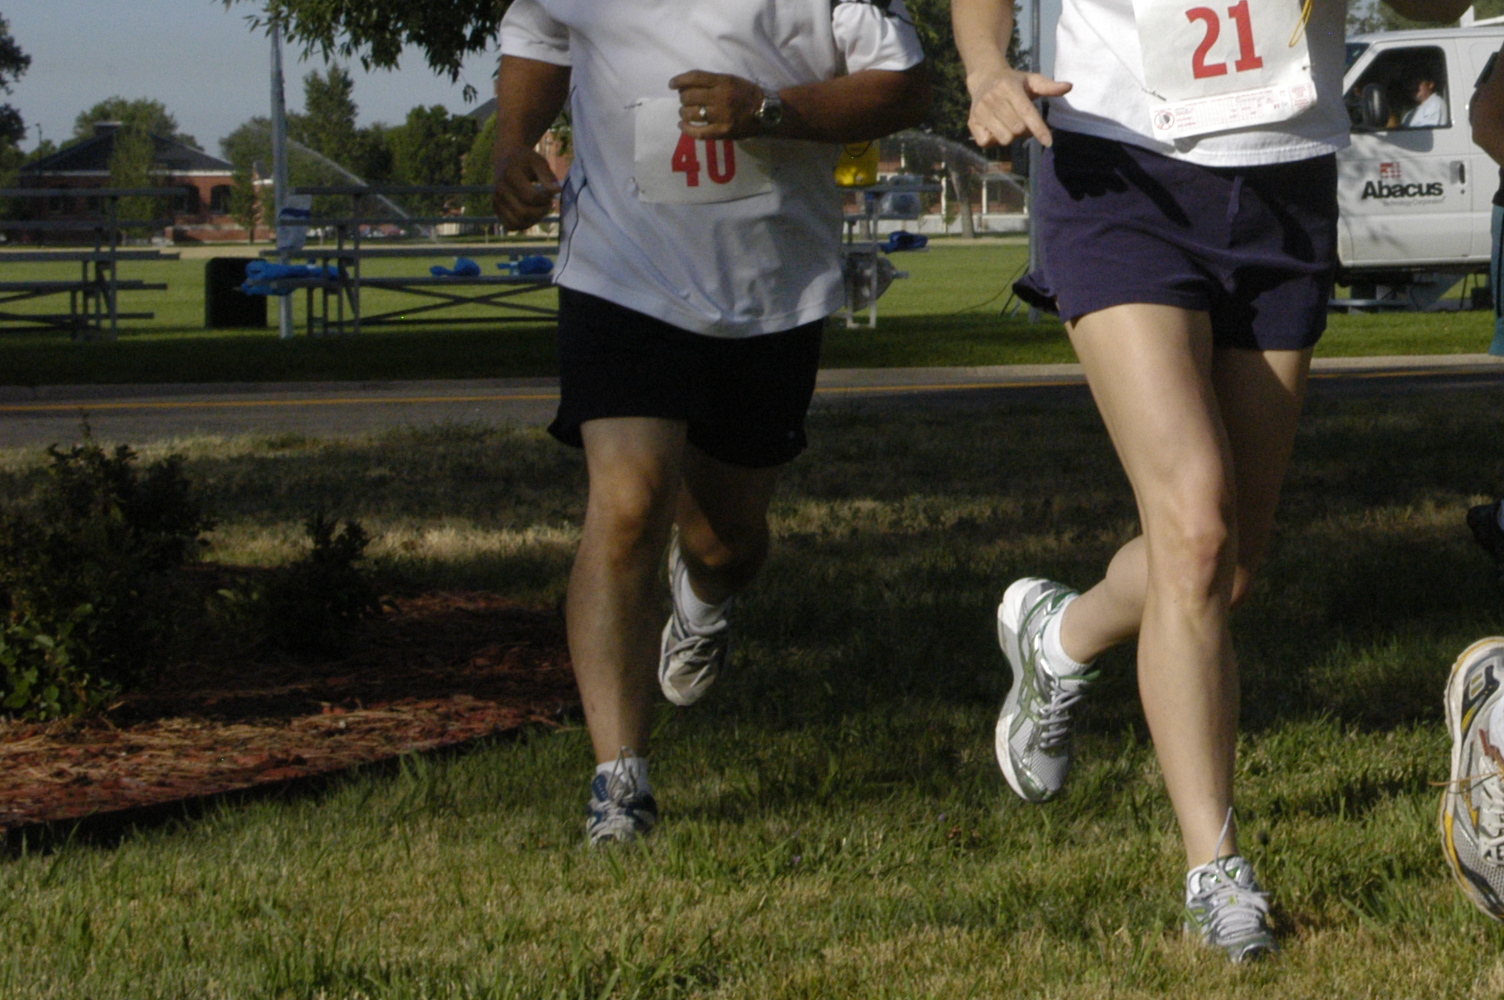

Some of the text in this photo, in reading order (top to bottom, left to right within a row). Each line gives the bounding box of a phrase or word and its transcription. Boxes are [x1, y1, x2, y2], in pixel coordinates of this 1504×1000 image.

[1185, 0, 1263, 80] 21
[671, 131, 736, 188] 40
[1361, 180, 1444, 200] Abacus
